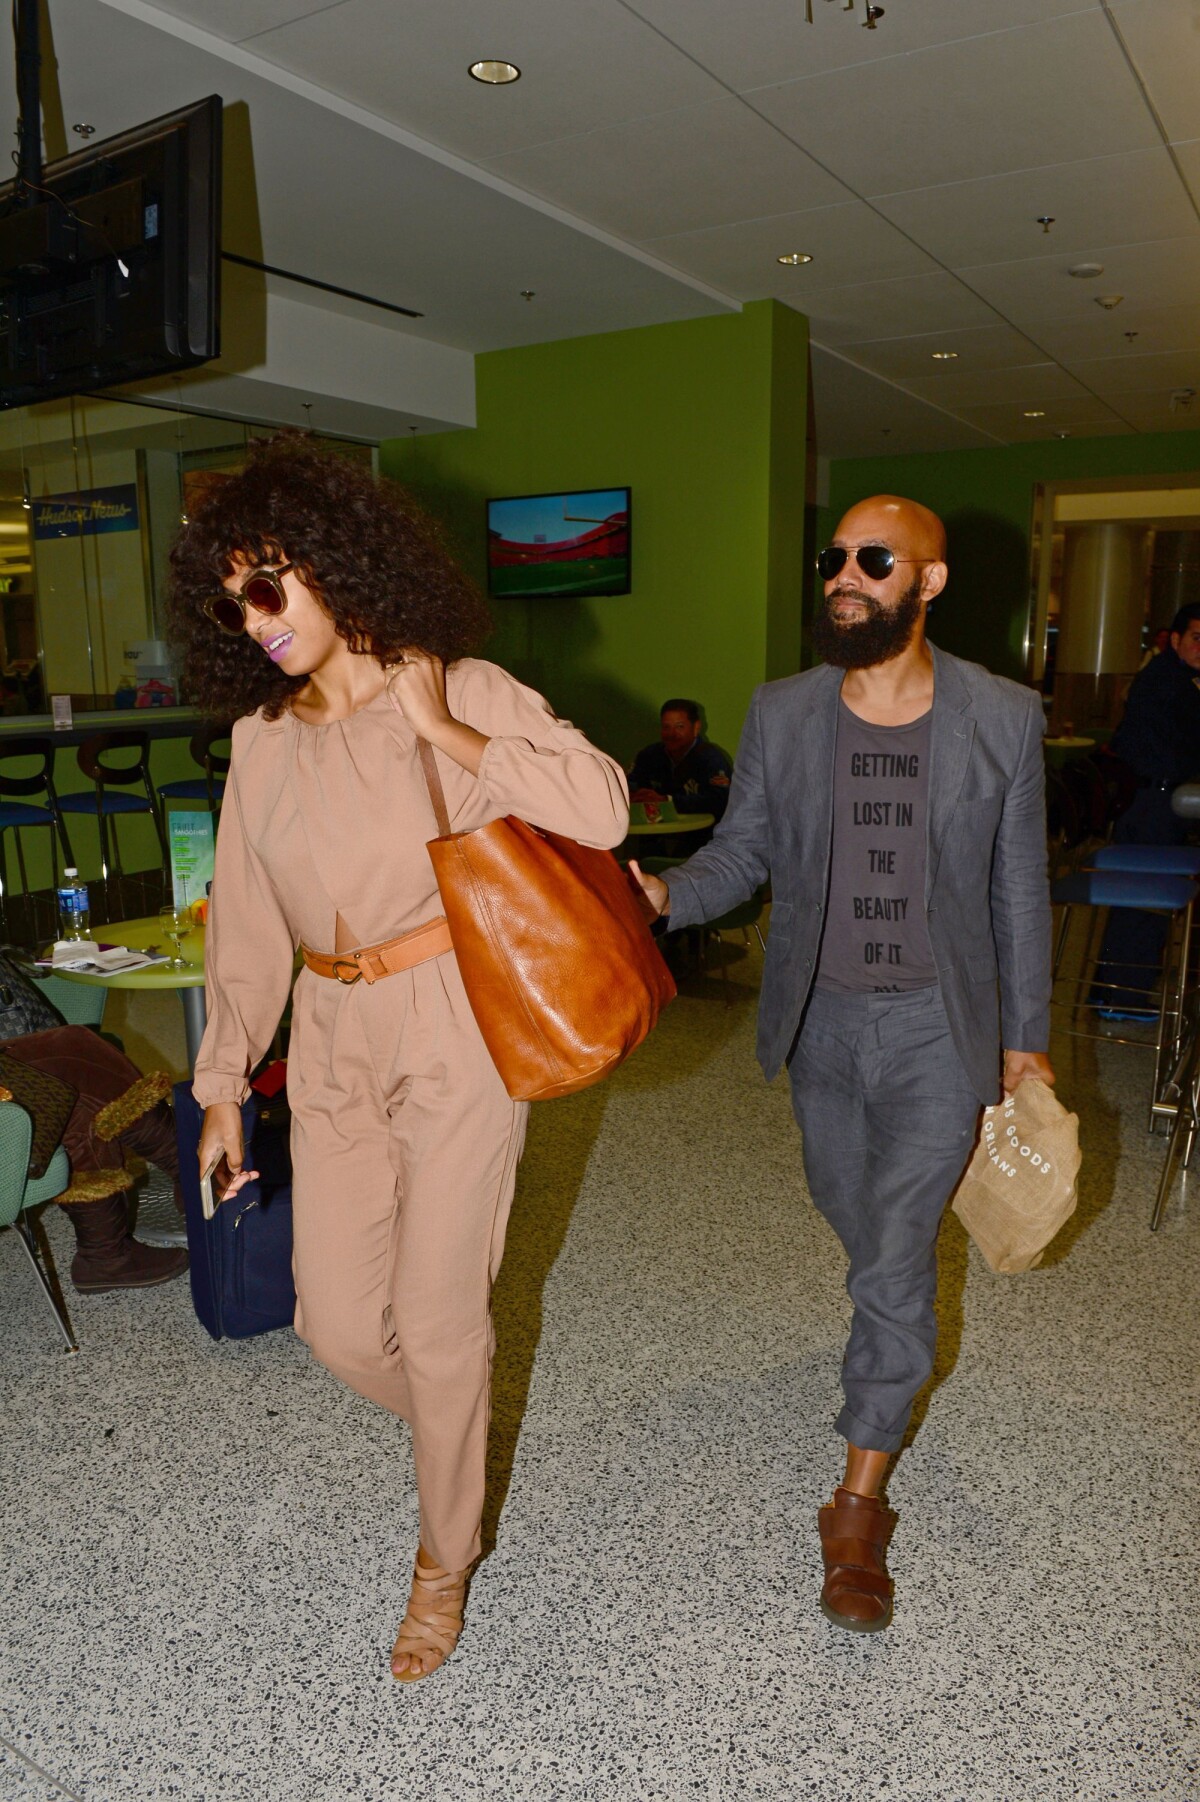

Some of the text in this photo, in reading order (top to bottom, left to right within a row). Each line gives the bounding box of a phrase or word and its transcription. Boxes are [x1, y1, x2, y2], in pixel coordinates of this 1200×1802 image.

[36, 500, 132, 526] Hudson News
[851, 752, 919, 778] GETTING
[853, 801, 913, 827] LOST IN
[868, 850, 896, 875] THE
[853, 897, 909, 922] BEAUTY
[864, 942, 902, 965] OF IT
[984, 1121, 1016, 1178] ORLEANS
[1006, 1125, 1051, 1174] GOODS
